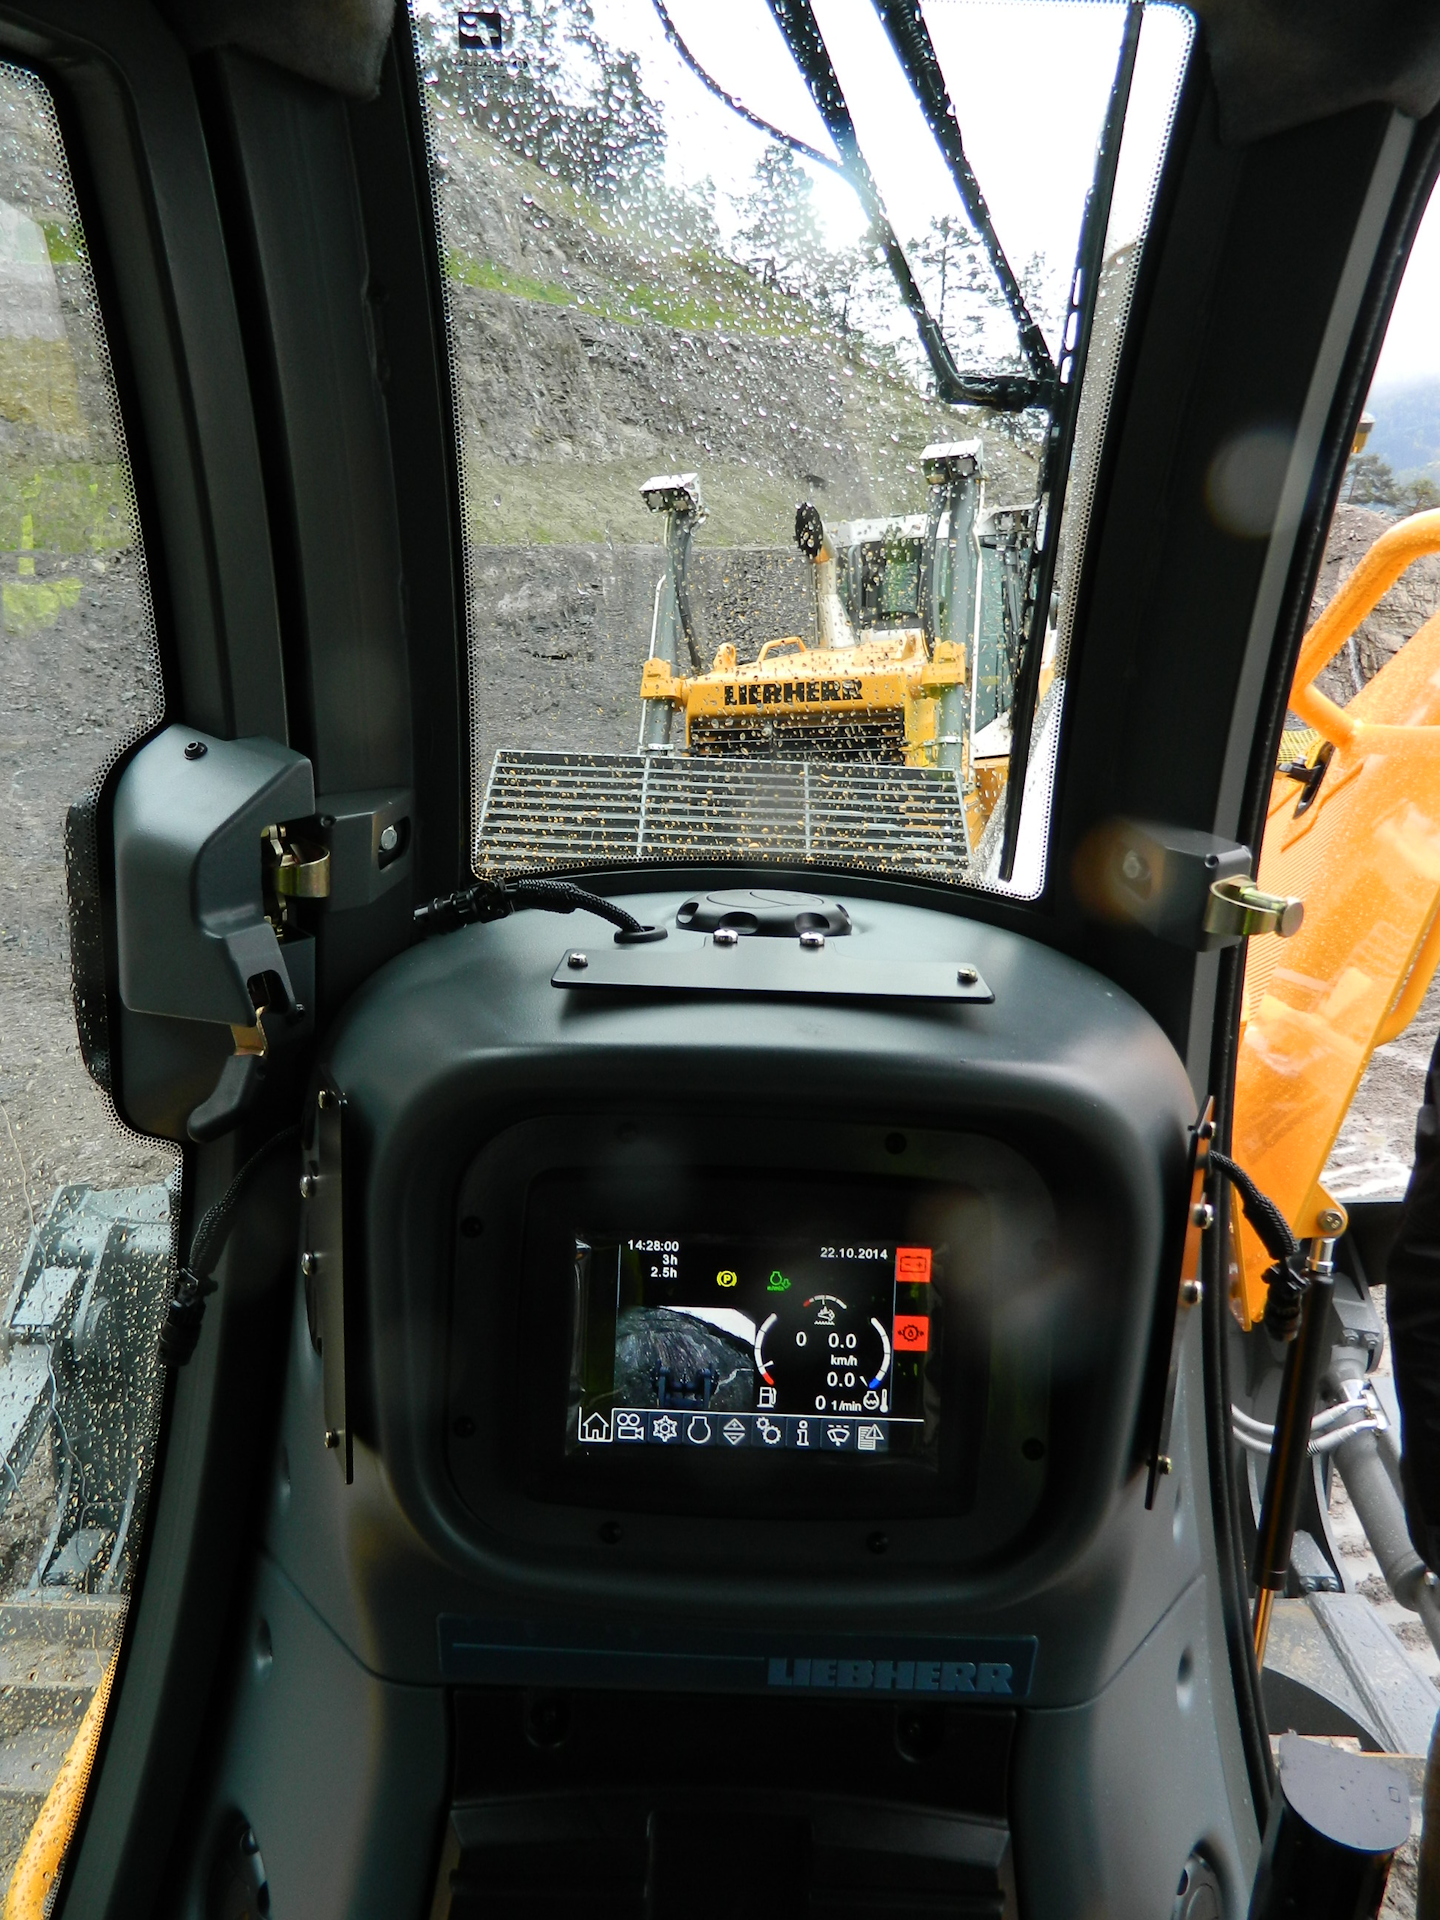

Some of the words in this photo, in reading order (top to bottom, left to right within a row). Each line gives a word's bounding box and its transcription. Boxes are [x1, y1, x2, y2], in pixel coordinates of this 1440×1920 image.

[724, 679, 863, 706] LIEBHERR
[627, 1239, 680, 1252] 14:28:00
[820, 1246, 888, 1260] 22.10.2014
[662, 1253, 678, 1266] 3h
[650, 1266, 678, 1278] 2.5h
[795, 1331, 807, 1347] 0
[828, 1332, 857, 1349] 0.0
[830, 1354, 858, 1366] km/h
[826, 1371, 856, 1388] 0.0
[815, 1395, 827, 1411] 0
[831, 1400, 862, 1412] 1/min
[767, 1658, 1014, 1694] LIEBHERR
